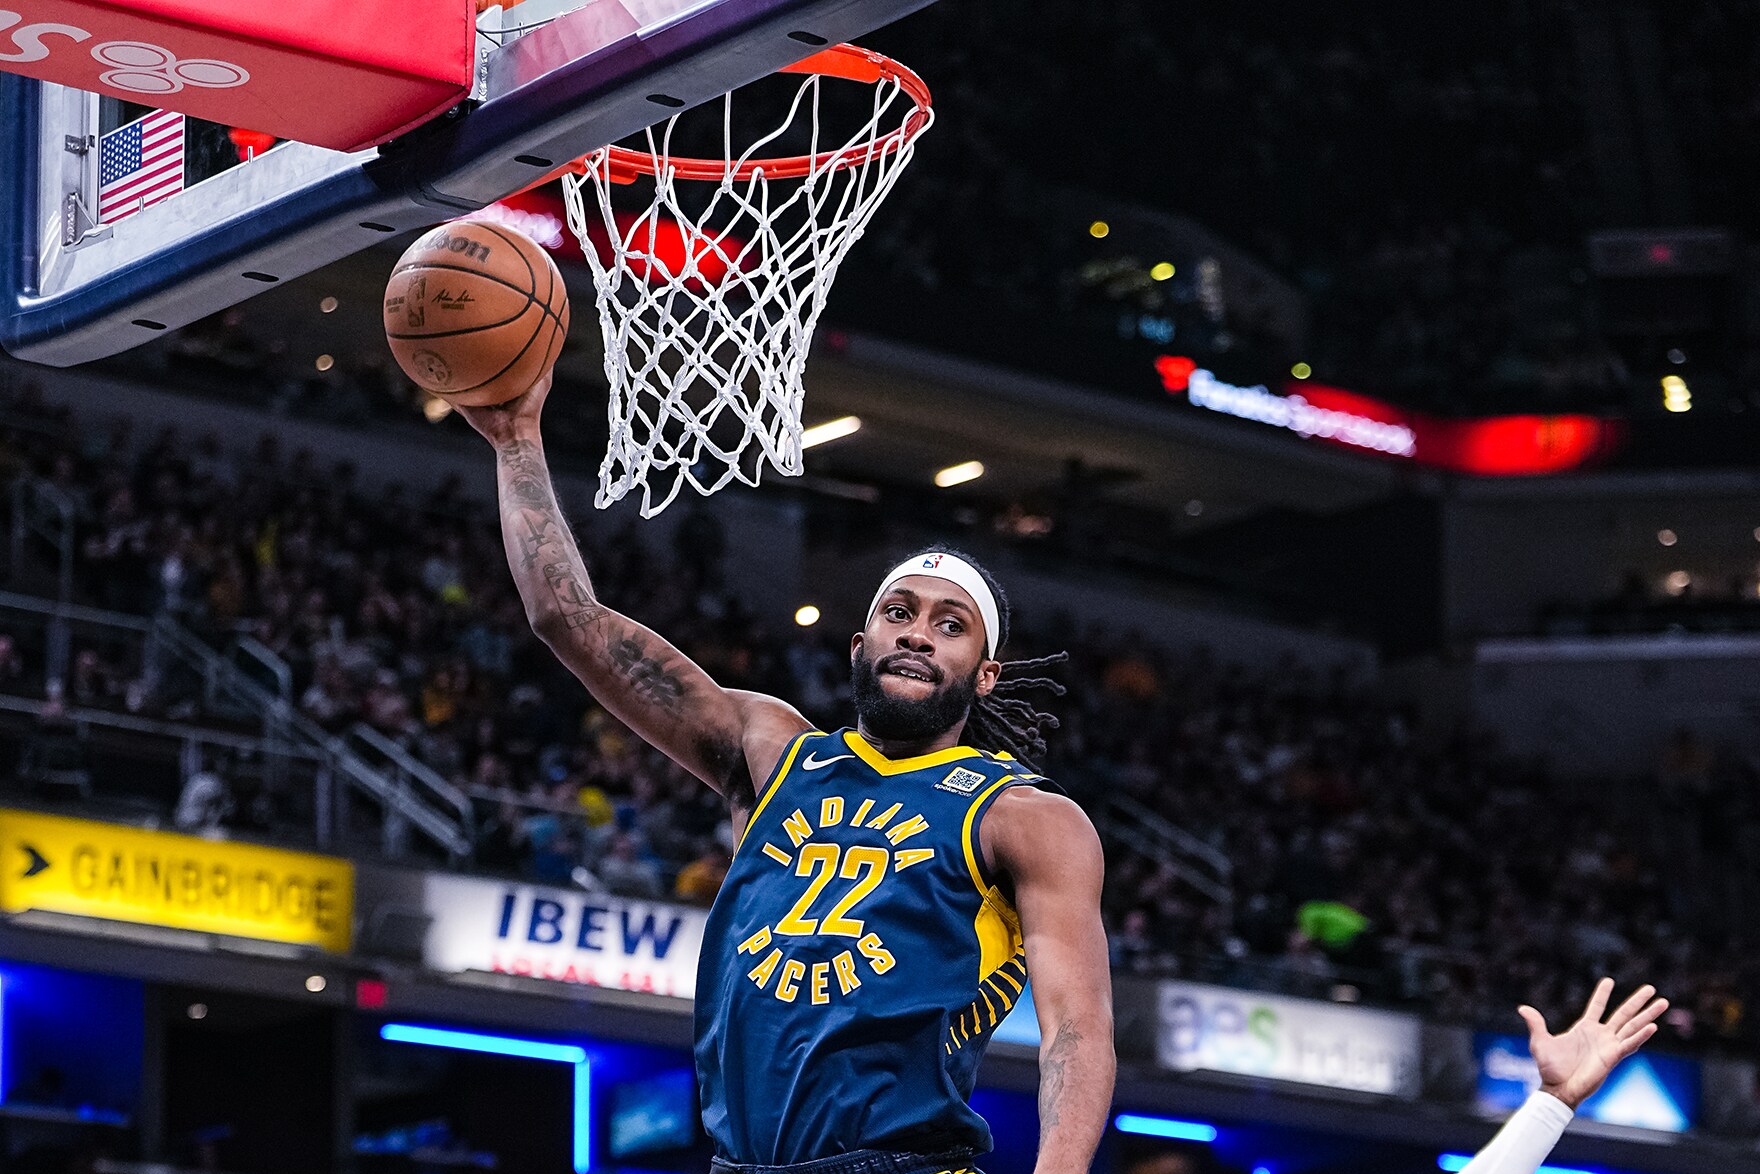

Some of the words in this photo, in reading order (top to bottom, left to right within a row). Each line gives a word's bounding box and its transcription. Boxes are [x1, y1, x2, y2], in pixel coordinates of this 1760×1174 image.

[762, 796, 934, 872] INDIANA
[70, 843, 335, 933] GAINBRIDGE
[498, 894, 683, 959] IBEW
[773, 843, 889, 938] 22
[737, 925, 896, 1005] PACERS
